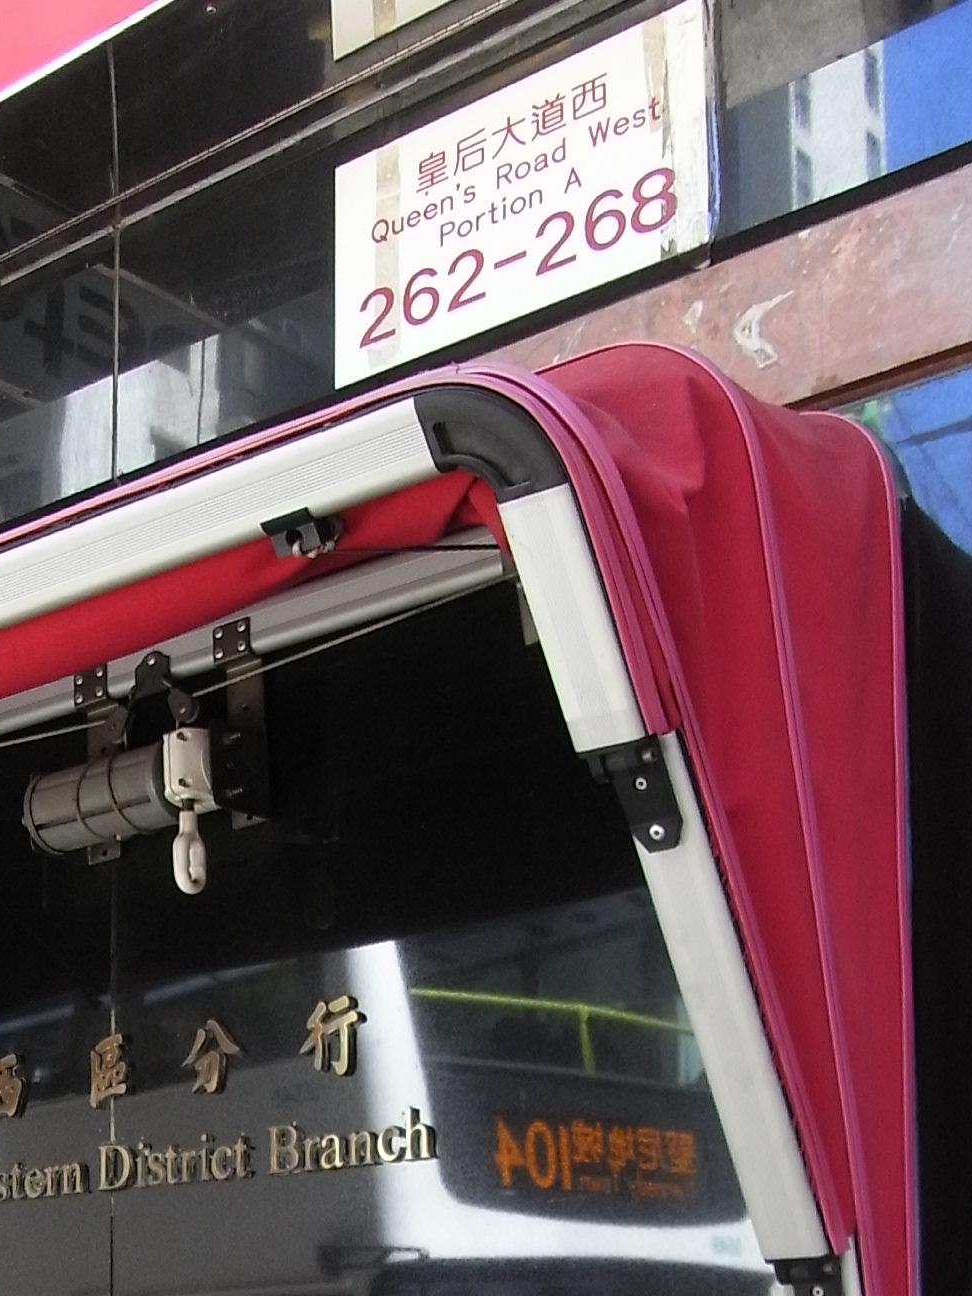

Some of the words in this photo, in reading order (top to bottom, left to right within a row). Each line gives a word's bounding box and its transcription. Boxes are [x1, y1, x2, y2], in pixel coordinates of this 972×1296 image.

[371, 183, 476, 244] Queen's
[497, 138, 567, 190] Road
[589, 97, 662, 147] West
[416, 73, 607, 194] 皇后大道西
[359, 167, 677, 349] 262-268
[441, 190, 543, 247] Portion
[564, 167, 582, 193] A
[97, 1132, 253, 1191] District
[269, 1106, 439, 1177] Branch
